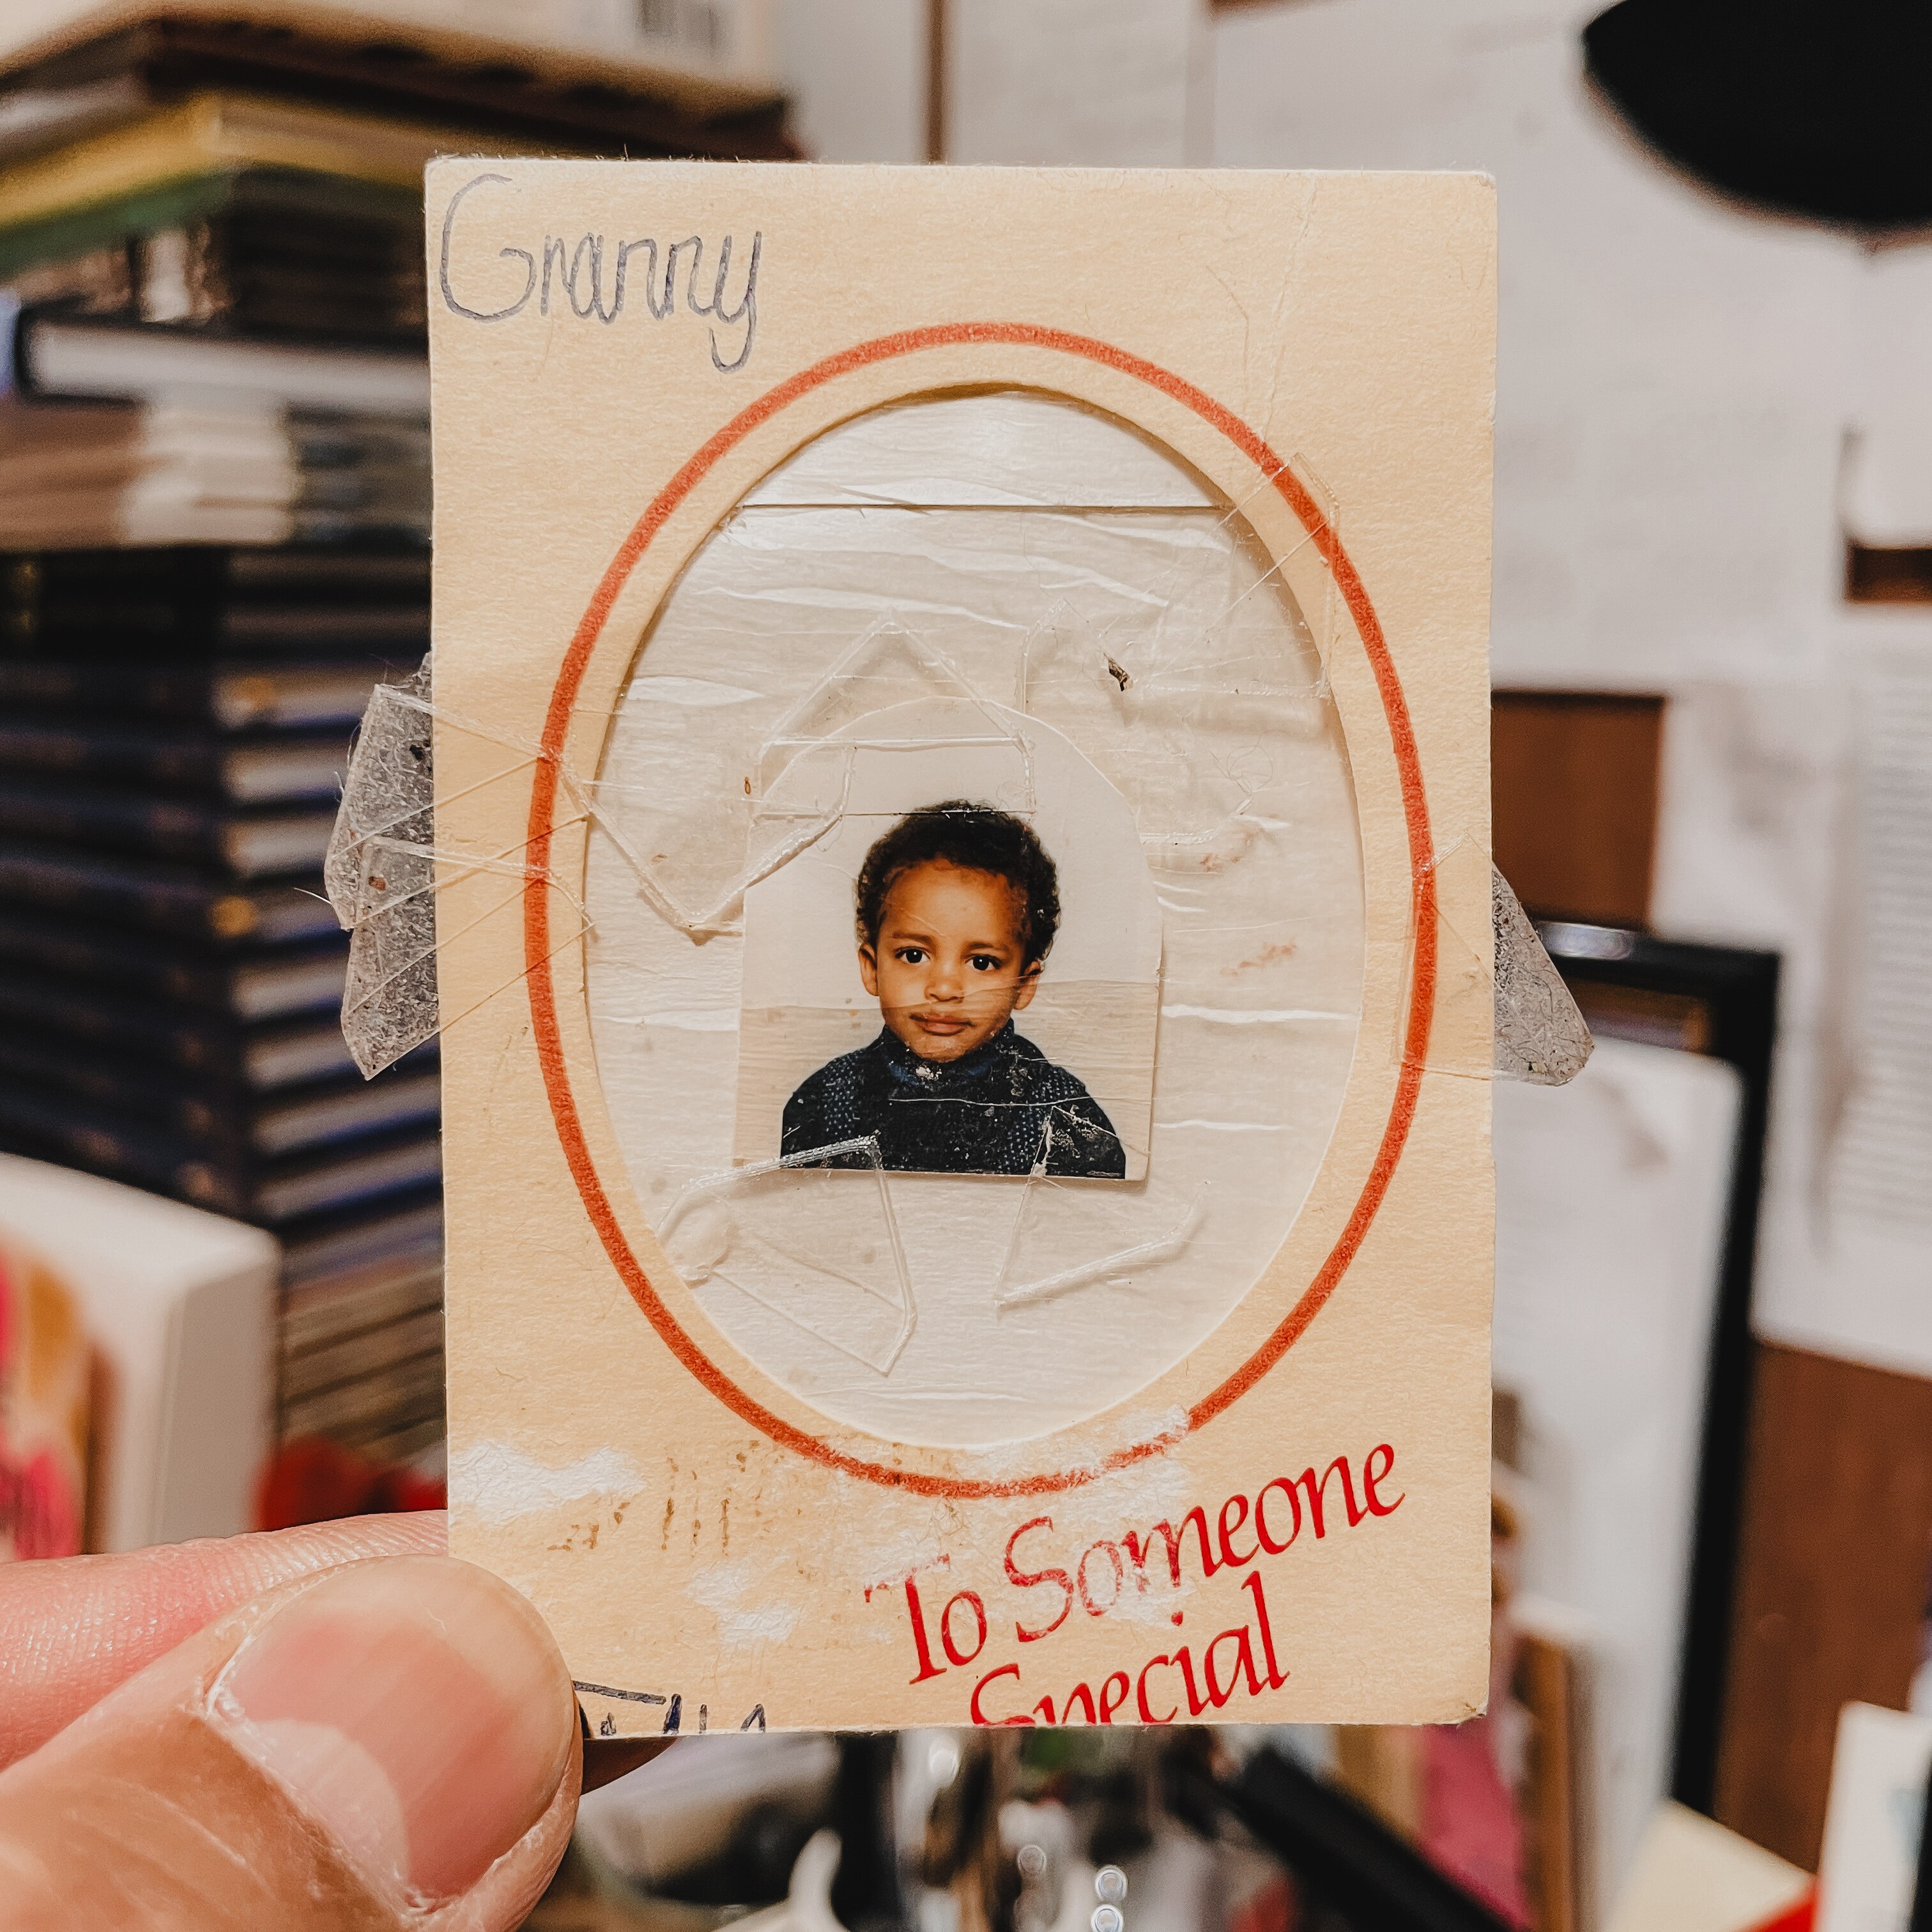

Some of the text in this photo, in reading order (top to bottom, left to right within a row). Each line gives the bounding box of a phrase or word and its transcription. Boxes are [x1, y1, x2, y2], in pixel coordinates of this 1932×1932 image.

[439, 172, 762, 373] Granny
[864, 1443, 1406, 1685] To Someone
